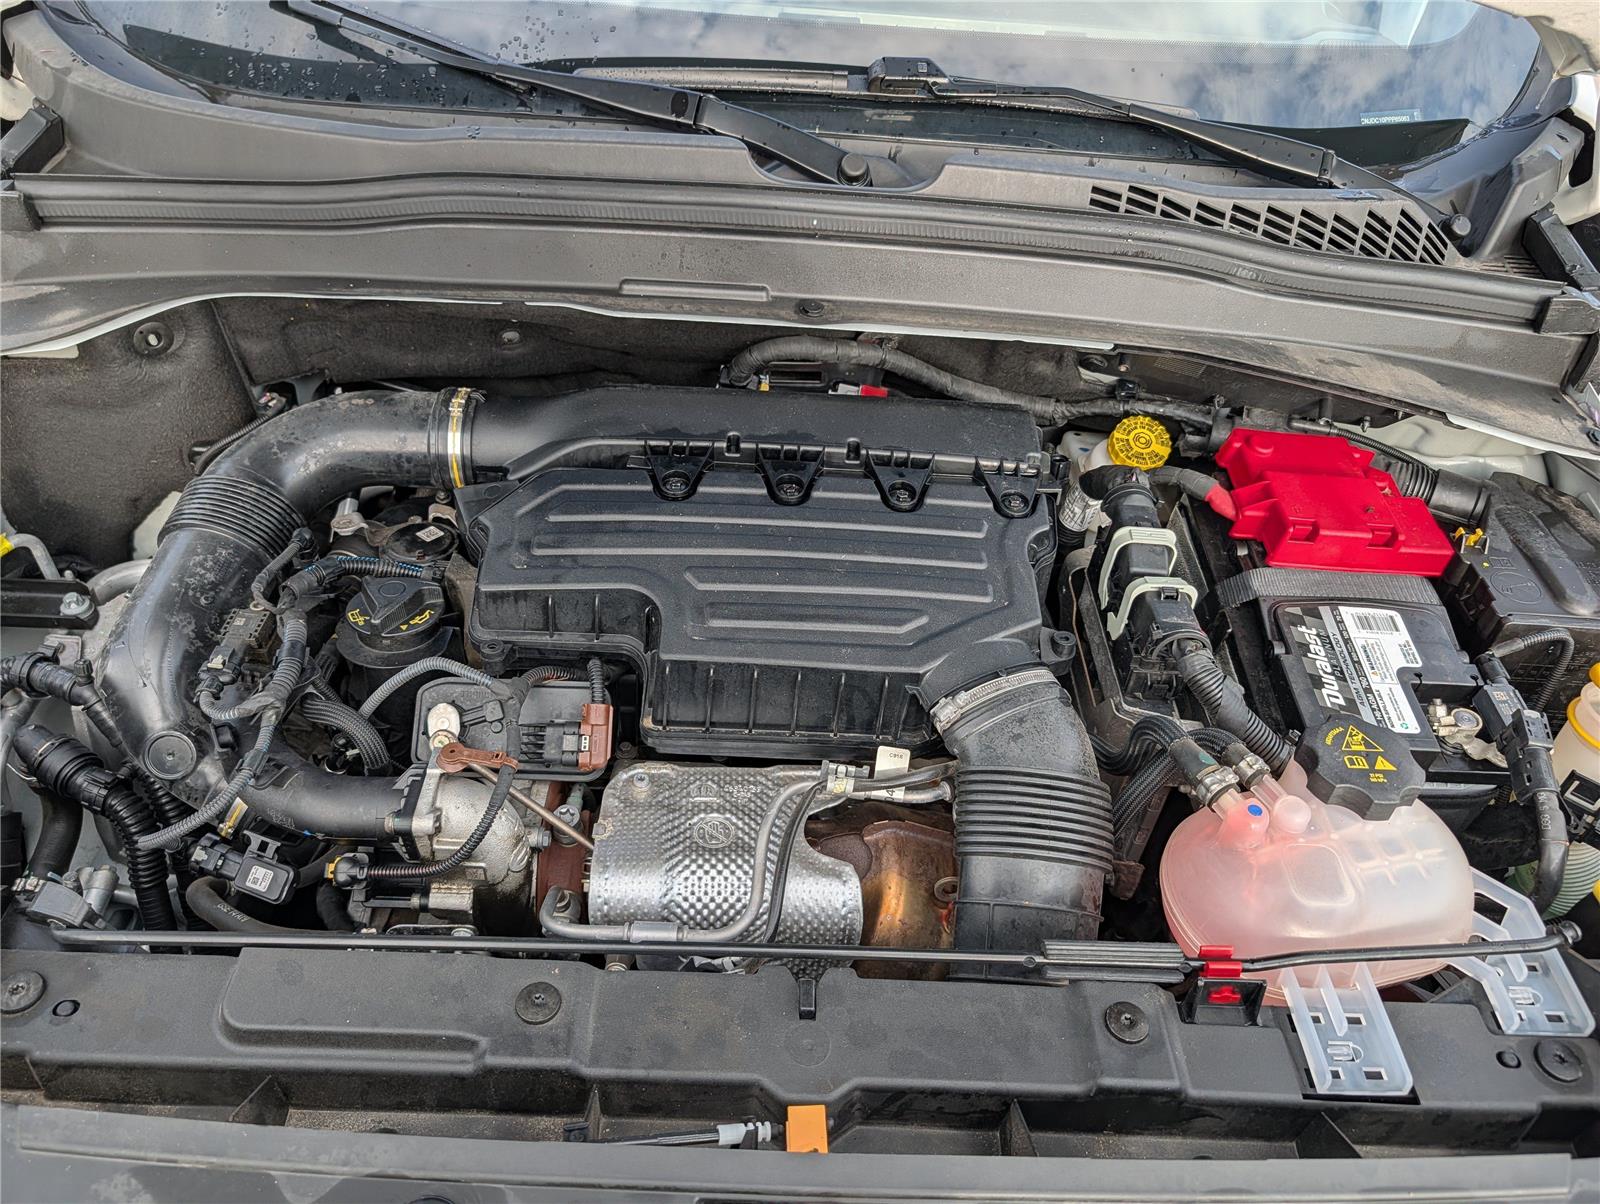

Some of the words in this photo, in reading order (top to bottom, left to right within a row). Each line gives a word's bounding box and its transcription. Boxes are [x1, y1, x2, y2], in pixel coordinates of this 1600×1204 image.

[1297, 624, 1347, 707] Duralast
[1318, 628, 1344, 678] PLATINUM
[1330, 631, 1356, 685] TECHNOLOGY
[1353, 686, 1367, 708] AGM
